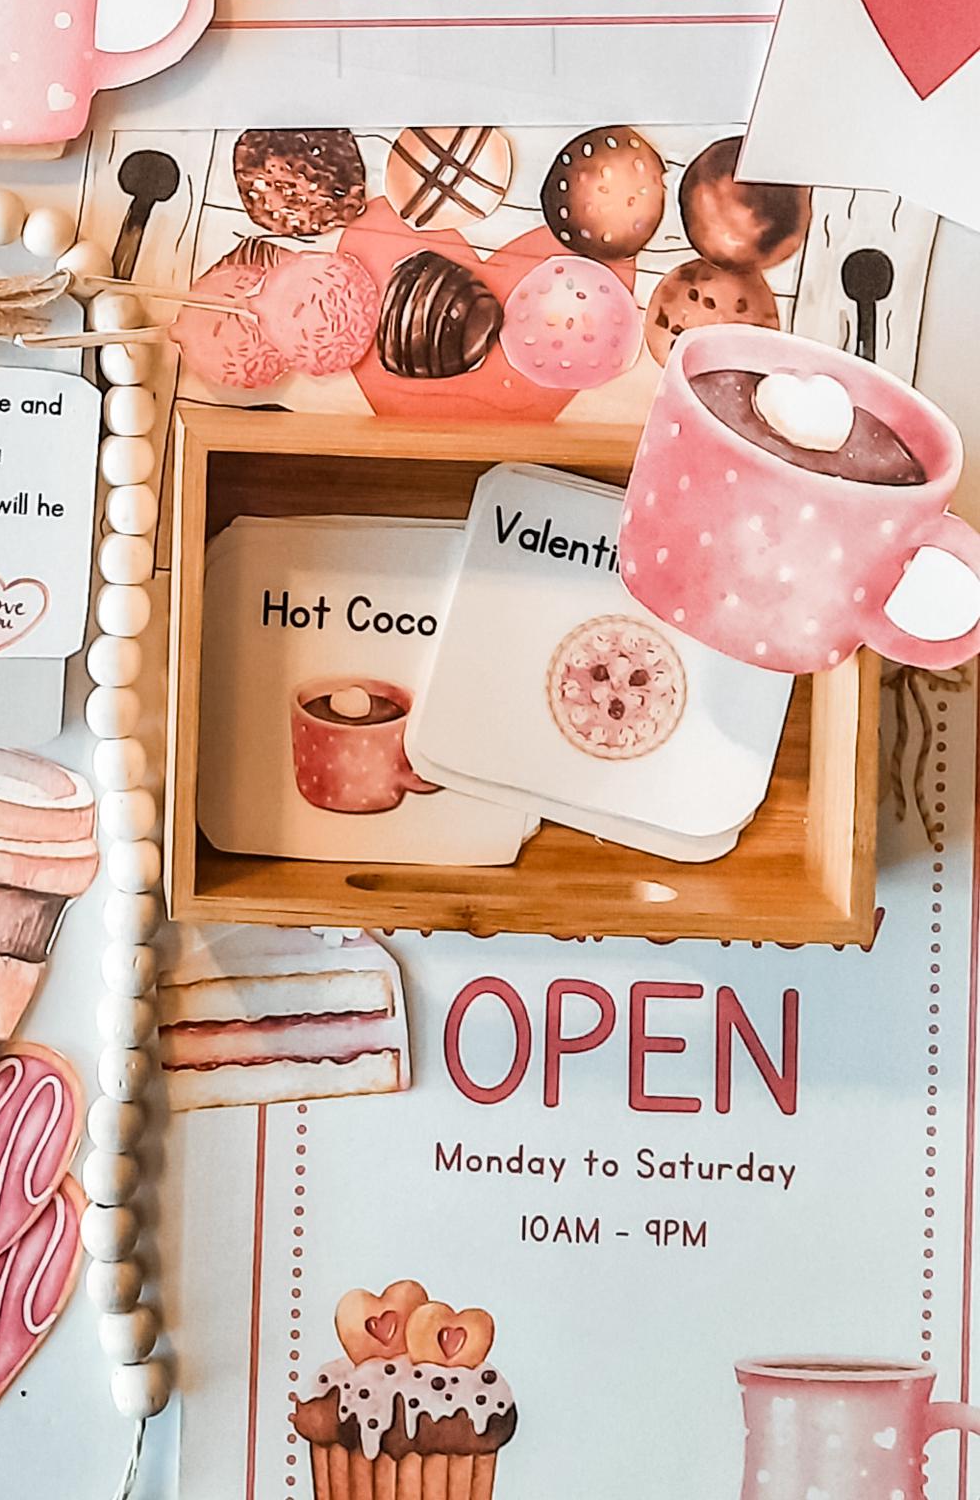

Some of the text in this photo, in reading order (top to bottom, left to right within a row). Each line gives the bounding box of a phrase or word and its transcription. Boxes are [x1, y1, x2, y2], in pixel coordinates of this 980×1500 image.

[20, 392, 63, 416] and
[37, 493, 64, 518] he
[495, 505, 620, 574] Valenti
[259, 586, 332, 630] Hot
[443, 976, 800, 1116] OPEN
[435, 1142, 796, 1191] Monday to Saturday
[521, 1215, 600, 1245] 10AM
[645, 1219, 707, 1248] 9PM
